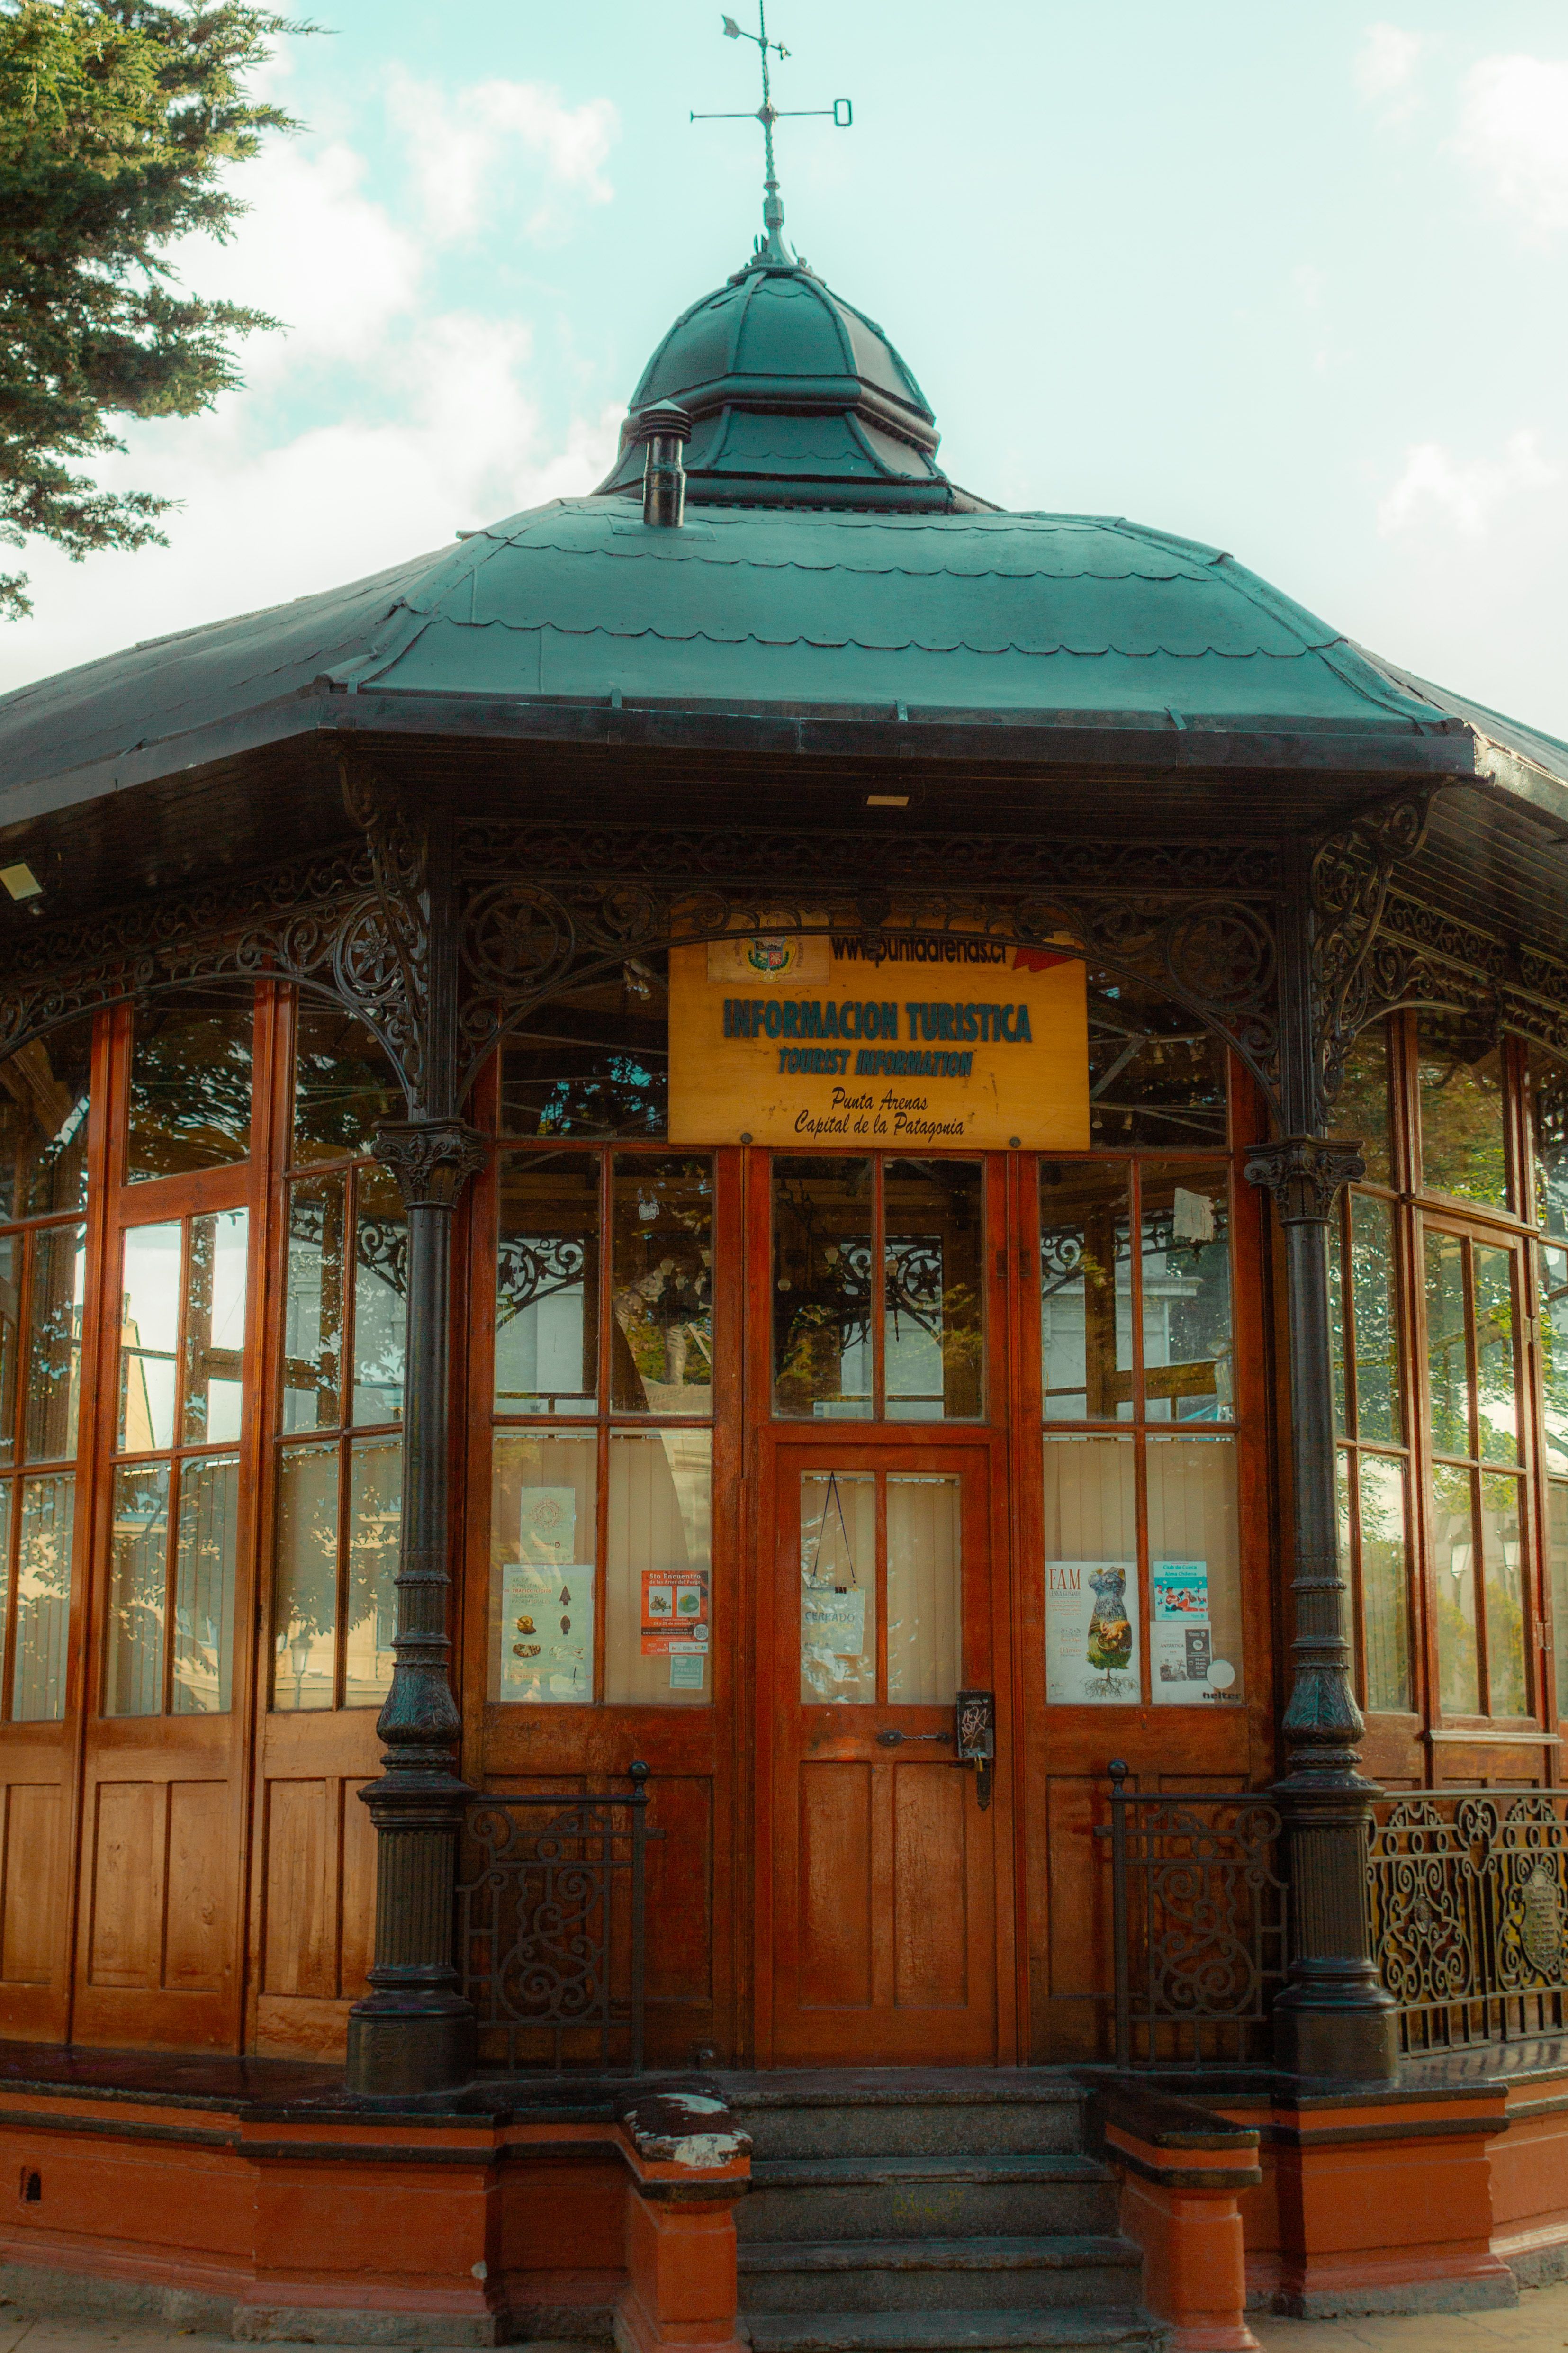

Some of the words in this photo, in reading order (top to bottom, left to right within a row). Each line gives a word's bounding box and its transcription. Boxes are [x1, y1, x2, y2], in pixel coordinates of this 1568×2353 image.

[723, 999, 898, 1040] INFORMACION
[906, 1002, 1033, 1043] TURISTICA
[778, 1047, 851, 1075] TOURIST
[855, 1049, 974, 1077] INFORMATION
[831, 1086, 875, 1111] Punta
[878, 1088, 929, 1111] Arenas
[794, 1109, 850, 1140] Capital
[853, 1113, 869, 1134] de
[873, 1113, 889, 1134] la
[893, 1111, 965, 1143] Patagonia
[1049, 1569, 1081, 1590] FAM
[805, 1611, 855, 1623] CERRADO
